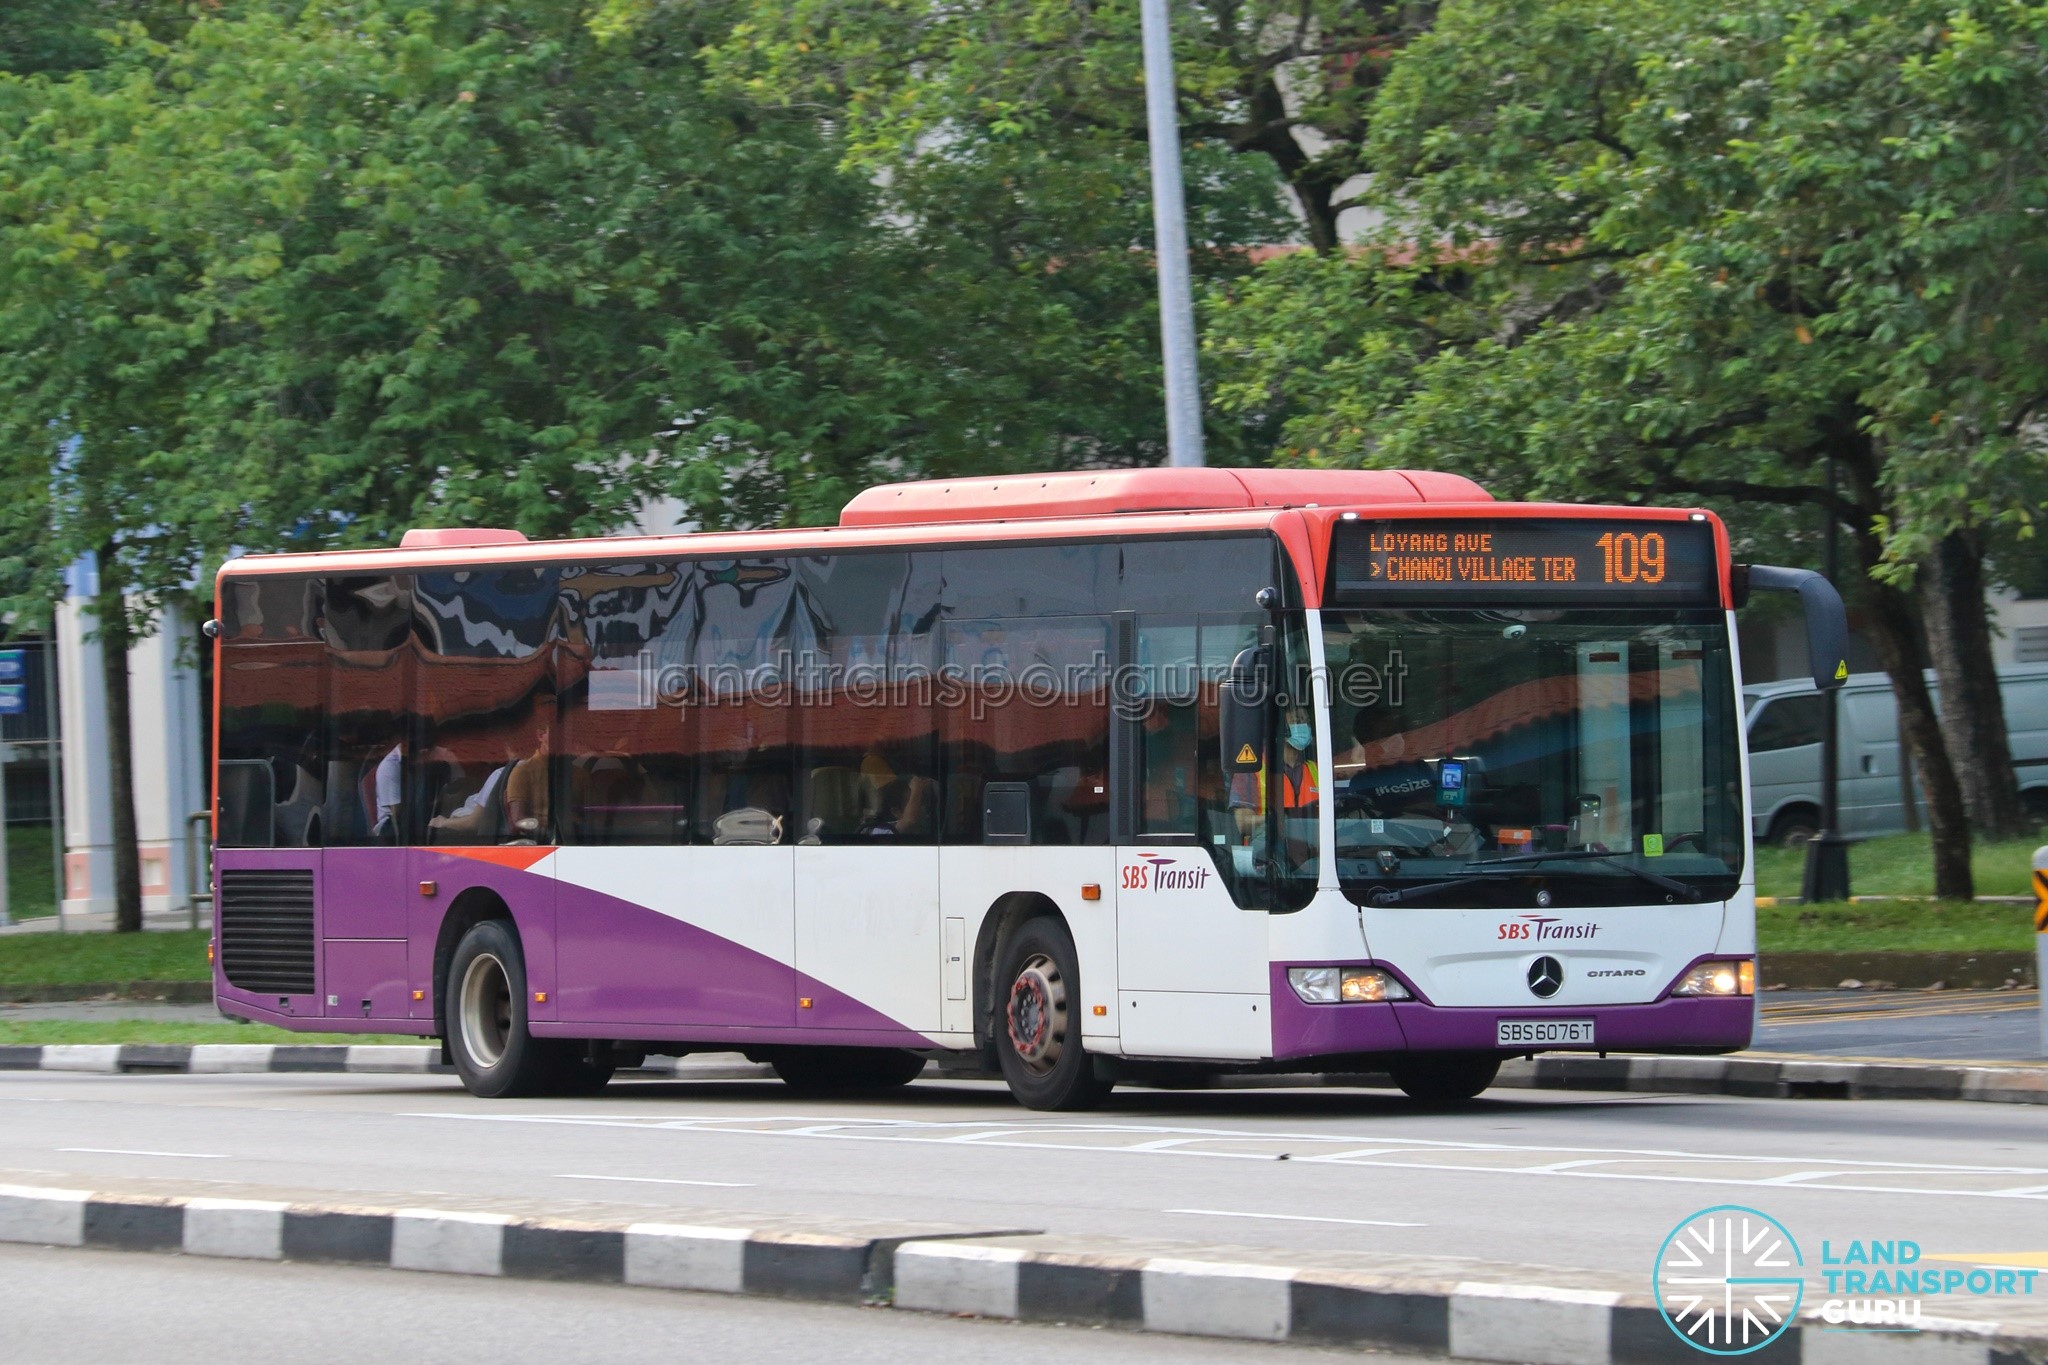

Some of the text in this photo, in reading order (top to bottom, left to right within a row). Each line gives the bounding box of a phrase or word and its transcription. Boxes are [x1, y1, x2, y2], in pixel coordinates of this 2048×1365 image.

[1369, 533, 1492, 552] LOYANG AVE
[1386, 557, 1576, 582] CHANGI VILLAGE TER
[1594, 532, 1665, 583] 109
[1121, 858, 1212, 894] SBS Transit
[1497, 917, 1604, 943] SBS Transit
[1586, 968, 1647, 979] CITARO
[1500, 1024, 1593, 1041] SBS6076T
